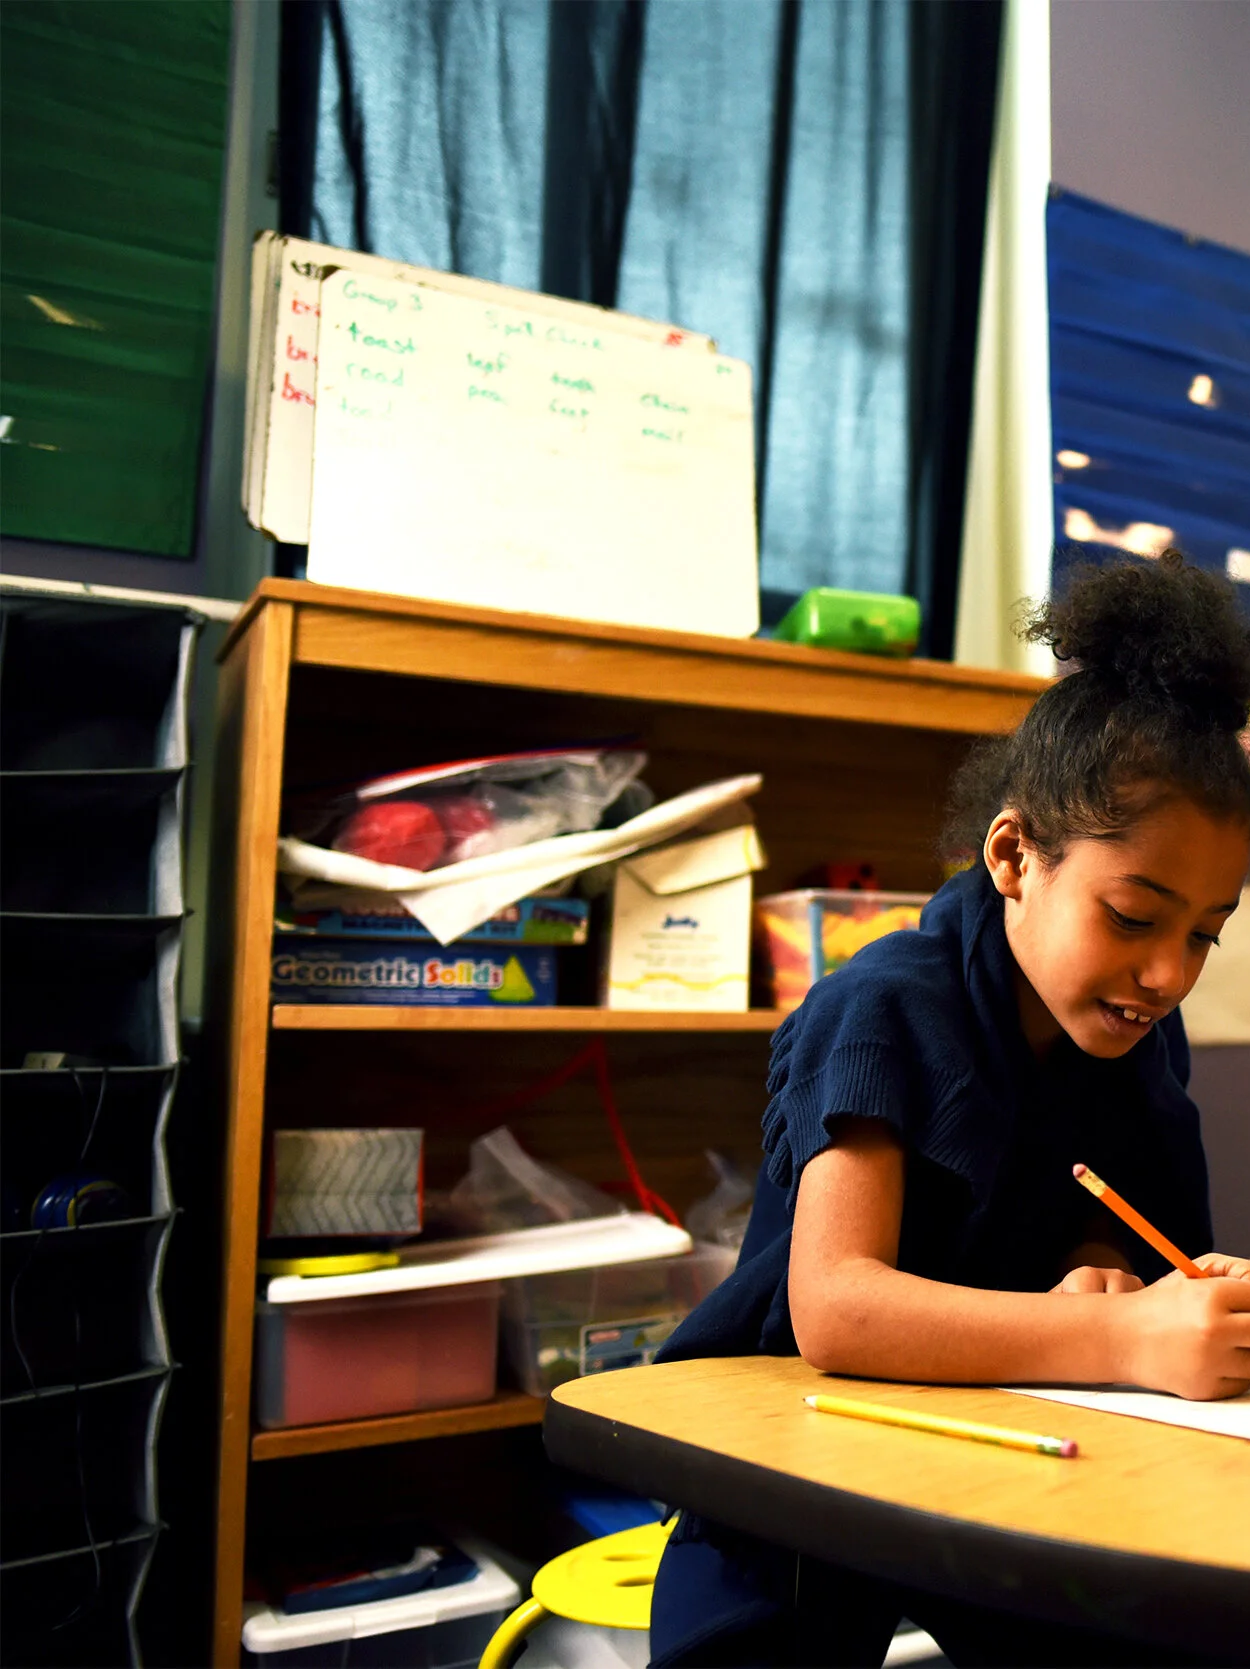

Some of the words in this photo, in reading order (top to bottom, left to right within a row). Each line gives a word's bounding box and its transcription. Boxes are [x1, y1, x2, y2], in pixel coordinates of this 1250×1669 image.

[342, 279, 398, 313] Group
[409, 292, 424, 312] 3
[347, 320, 416, 355] toast
[345, 362, 405, 388] road
[270, 955, 417, 985] Geometric
[423, 956, 504, 988] Solids
